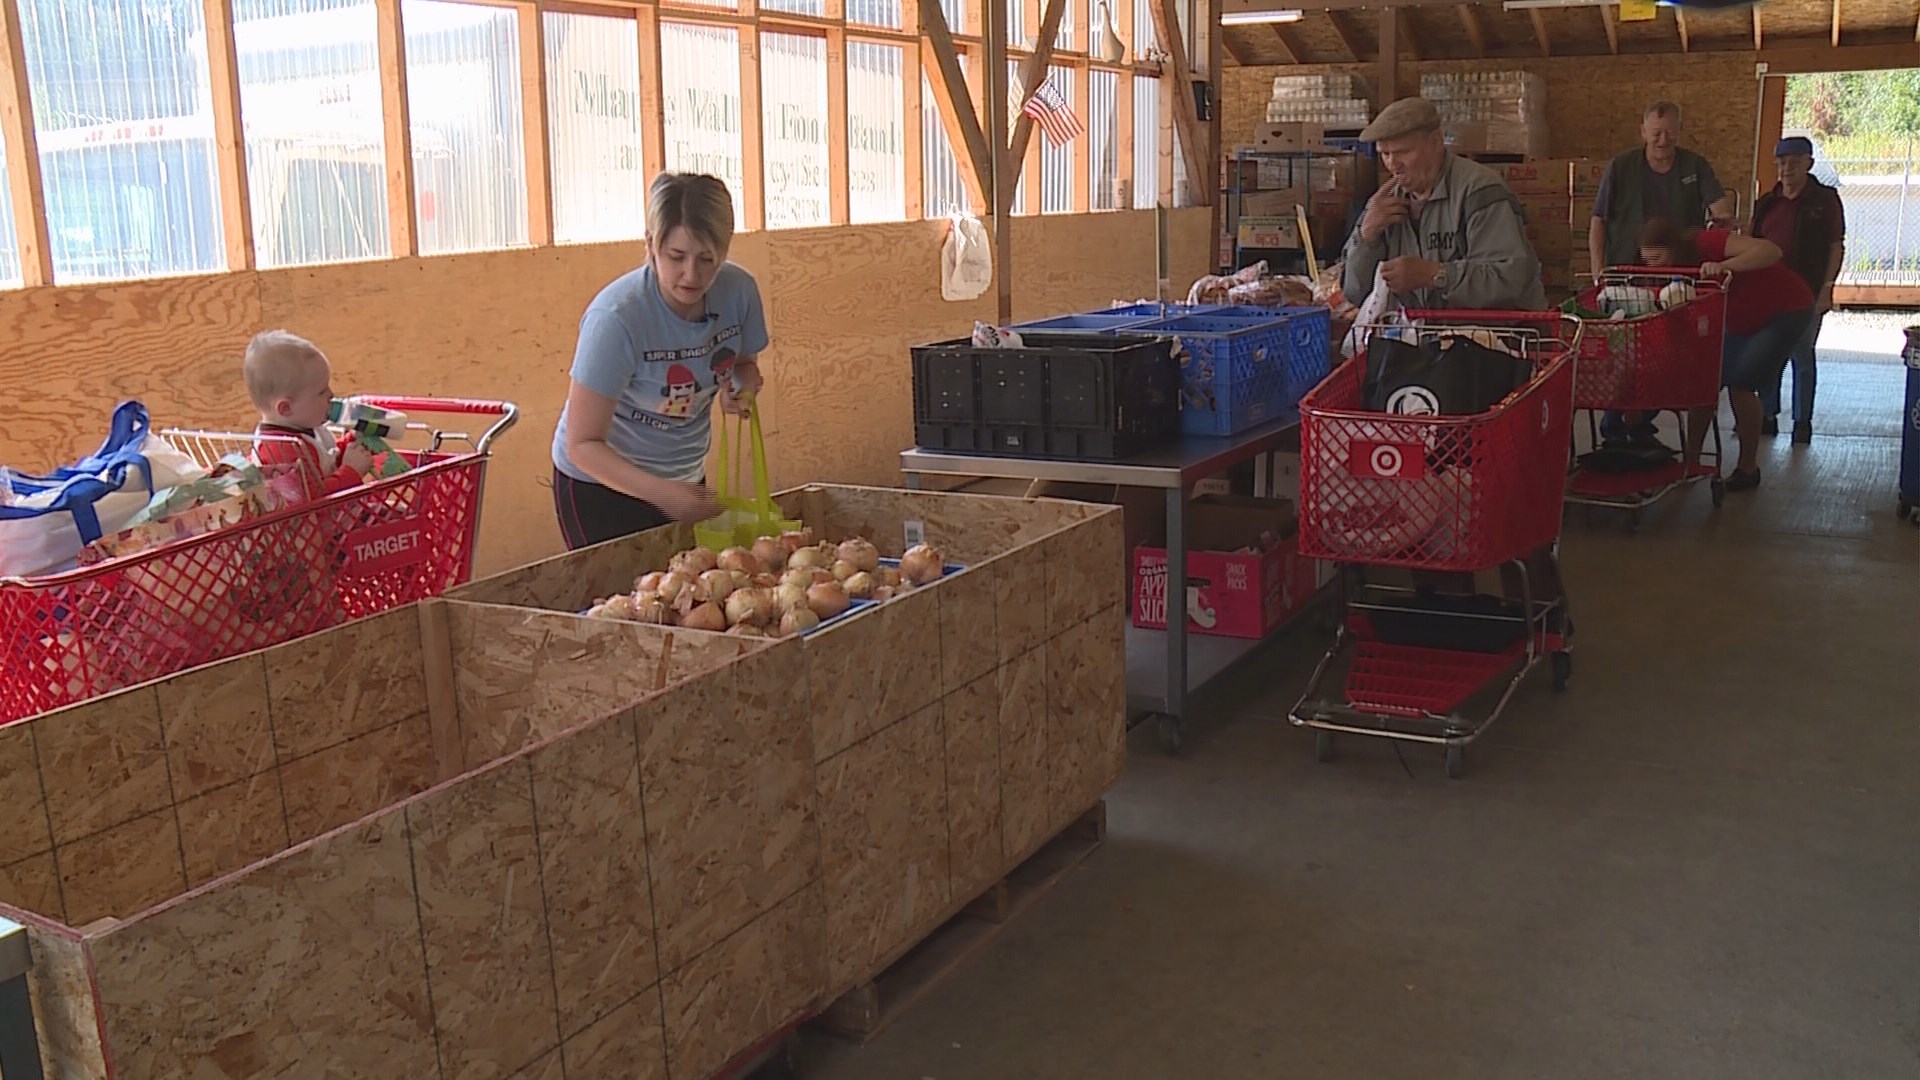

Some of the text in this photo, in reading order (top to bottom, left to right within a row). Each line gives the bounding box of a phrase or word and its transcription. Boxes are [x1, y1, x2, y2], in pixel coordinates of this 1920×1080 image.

[1427, 232, 1454, 250] RMY
[353, 530, 420, 562] TARGET
[1139, 566, 1168, 577] ORGAN
